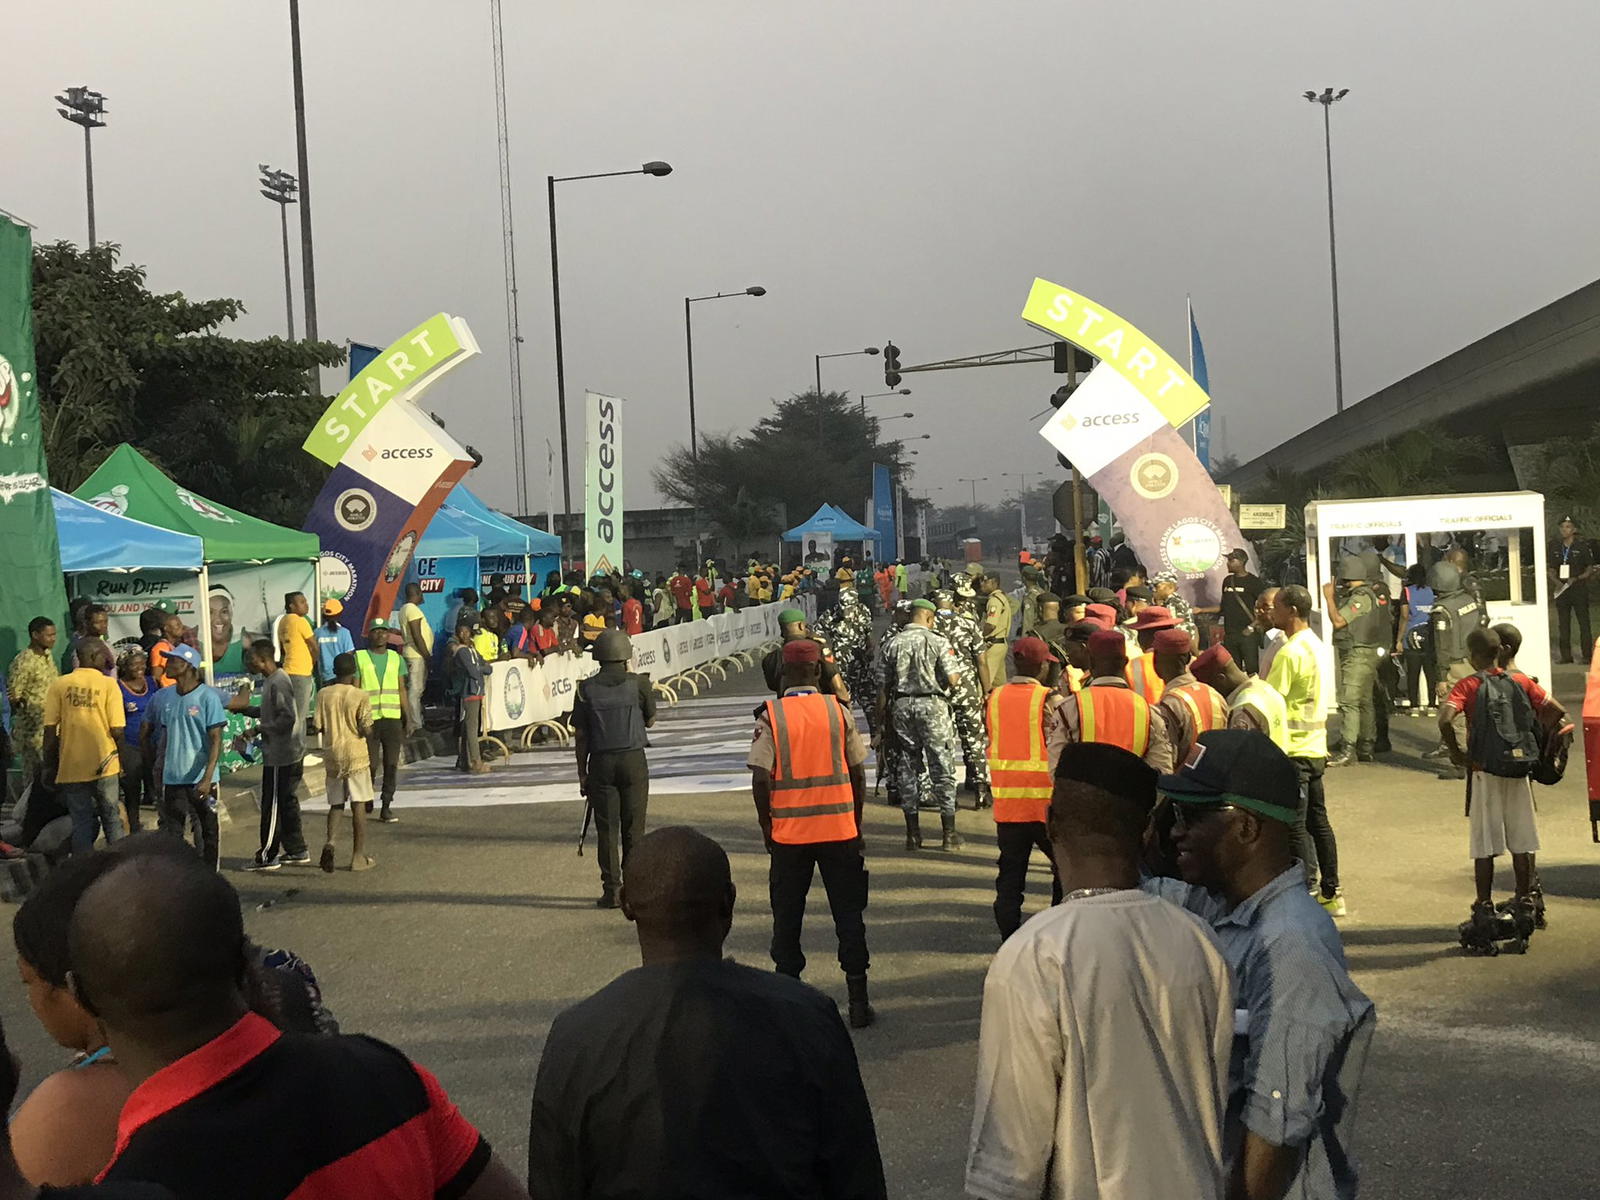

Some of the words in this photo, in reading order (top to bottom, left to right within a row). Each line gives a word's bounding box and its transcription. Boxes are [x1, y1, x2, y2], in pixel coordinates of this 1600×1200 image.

[1046, 294, 1185, 397] START
[325, 329, 435, 443] START
[1082, 412, 1140, 427] access
[381, 447, 434, 459] access
[598, 399, 615, 543] access
[1172, 517, 1199, 529] LAGOS
[1200, 518, 1217, 530] CITY
[1364, 520, 1402, 528] OFFICIALS
[1440, 516, 1472, 524] TRAFFIC
[1474, 514, 1512, 522] OFFICIALS
[418, 558, 438, 576] CE
[497, 556, 527, 571] RAC
[335, 552, 350, 563] CITY
[343, 563, 358, 601] MARATHON
[96, 579, 129, 596] RUN
[132, 578, 171, 595] DIFF
[420, 579, 441, 591] CITY
[118, 603, 140, 612] AND
